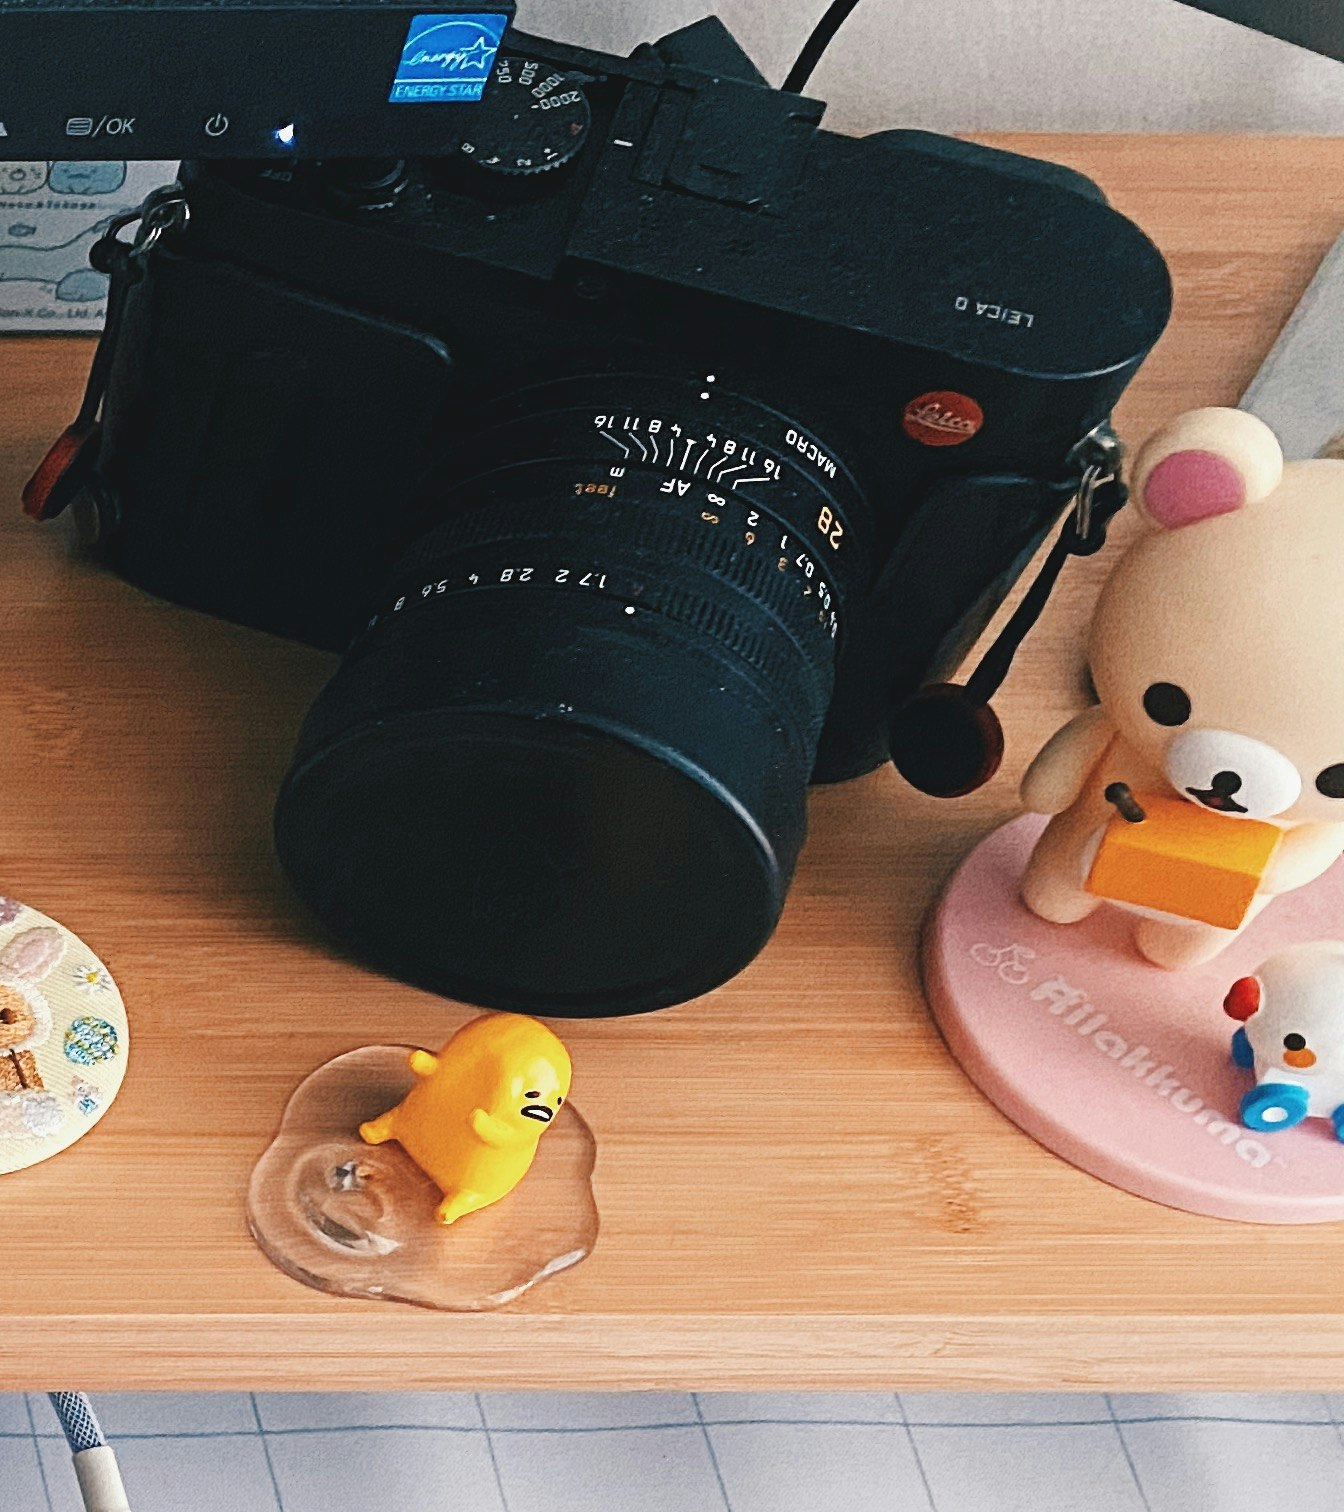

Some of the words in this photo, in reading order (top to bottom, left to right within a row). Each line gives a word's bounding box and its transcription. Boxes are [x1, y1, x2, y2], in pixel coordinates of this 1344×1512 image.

[518, 61, 539, 86] 500
[395, 84, 445, 98] ENERGY
[444, 83, 483, 97] STAR
[531, 73, 566, 98] 1000
[539, 90, 582, 111] 2000
[974, 301, 1036, 329] LEICA
[593, 415, 615, 429] 16
[623, 416, 640, 431] 11
[647, 419, 663, 434] 8
[670, 423, 682, 438] 4
[706, 433, 717, 448] 4
[723, 439, 737, 455] 8
[741, 447, 757, 466] 11
[763, 458, 781, 480] 16
[785, 429, 837, 479] MACRO
[609, 466, 626, 478] m
[574, 483, 618, 498] feet
[659, 478, 692, 497] AF
[817, 506, 844, 551] 28
[747, 510, 760, 527] 2
[780, 534, 789, 550] 1
[795, 553, 815, 578] 0.7
[499, 567, 535, 583] 2.8
[554, 568, 571, 583] 2
[578, 572, 607, 589] 1.7
